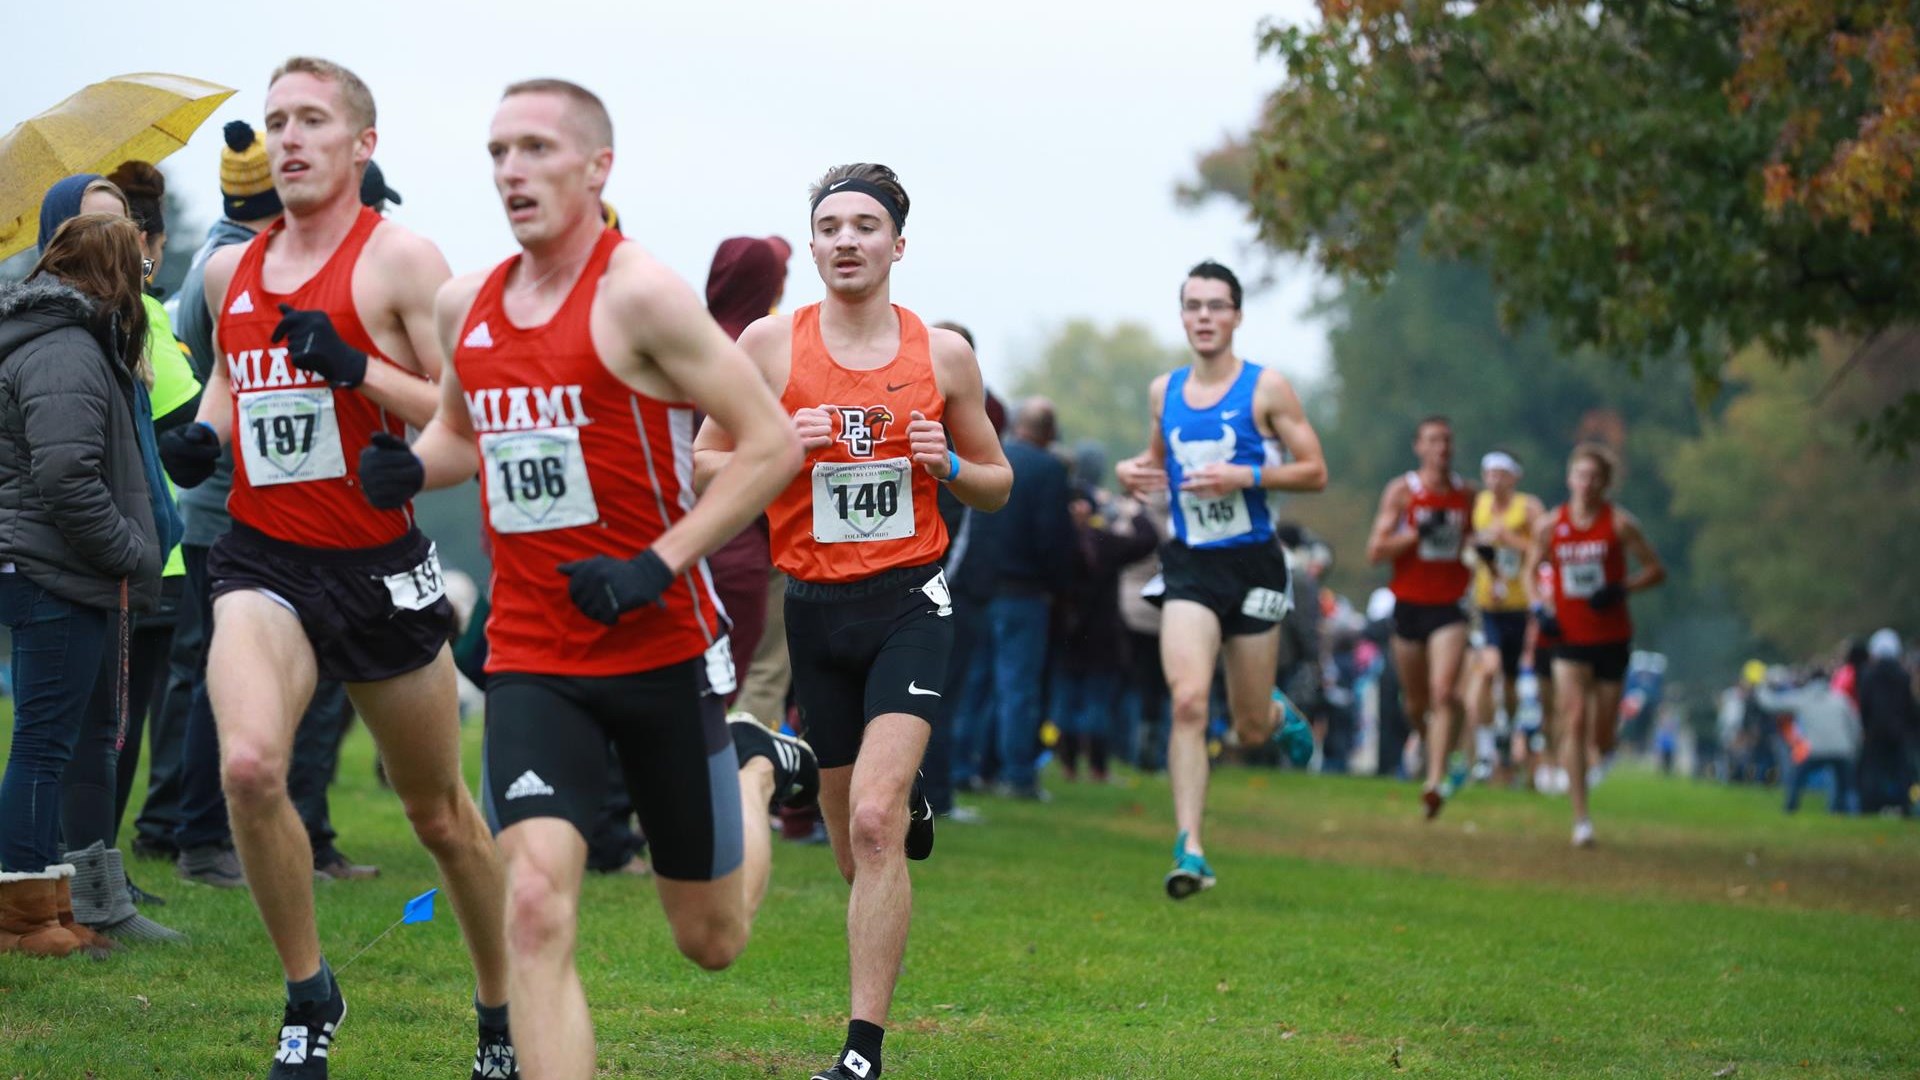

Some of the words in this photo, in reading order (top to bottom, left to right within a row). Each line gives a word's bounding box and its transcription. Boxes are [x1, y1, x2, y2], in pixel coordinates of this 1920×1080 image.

[227, 348, 325, 390] MIA
[464, 385, 593, 431] MIAMI
[252, 413, 316, 458] 197
[500, 456, 567, 503] 196
[833, 480, 898, 520] 140
[1191, 500, 1235, 527] 145
[408, 560, 444, 601] 19
